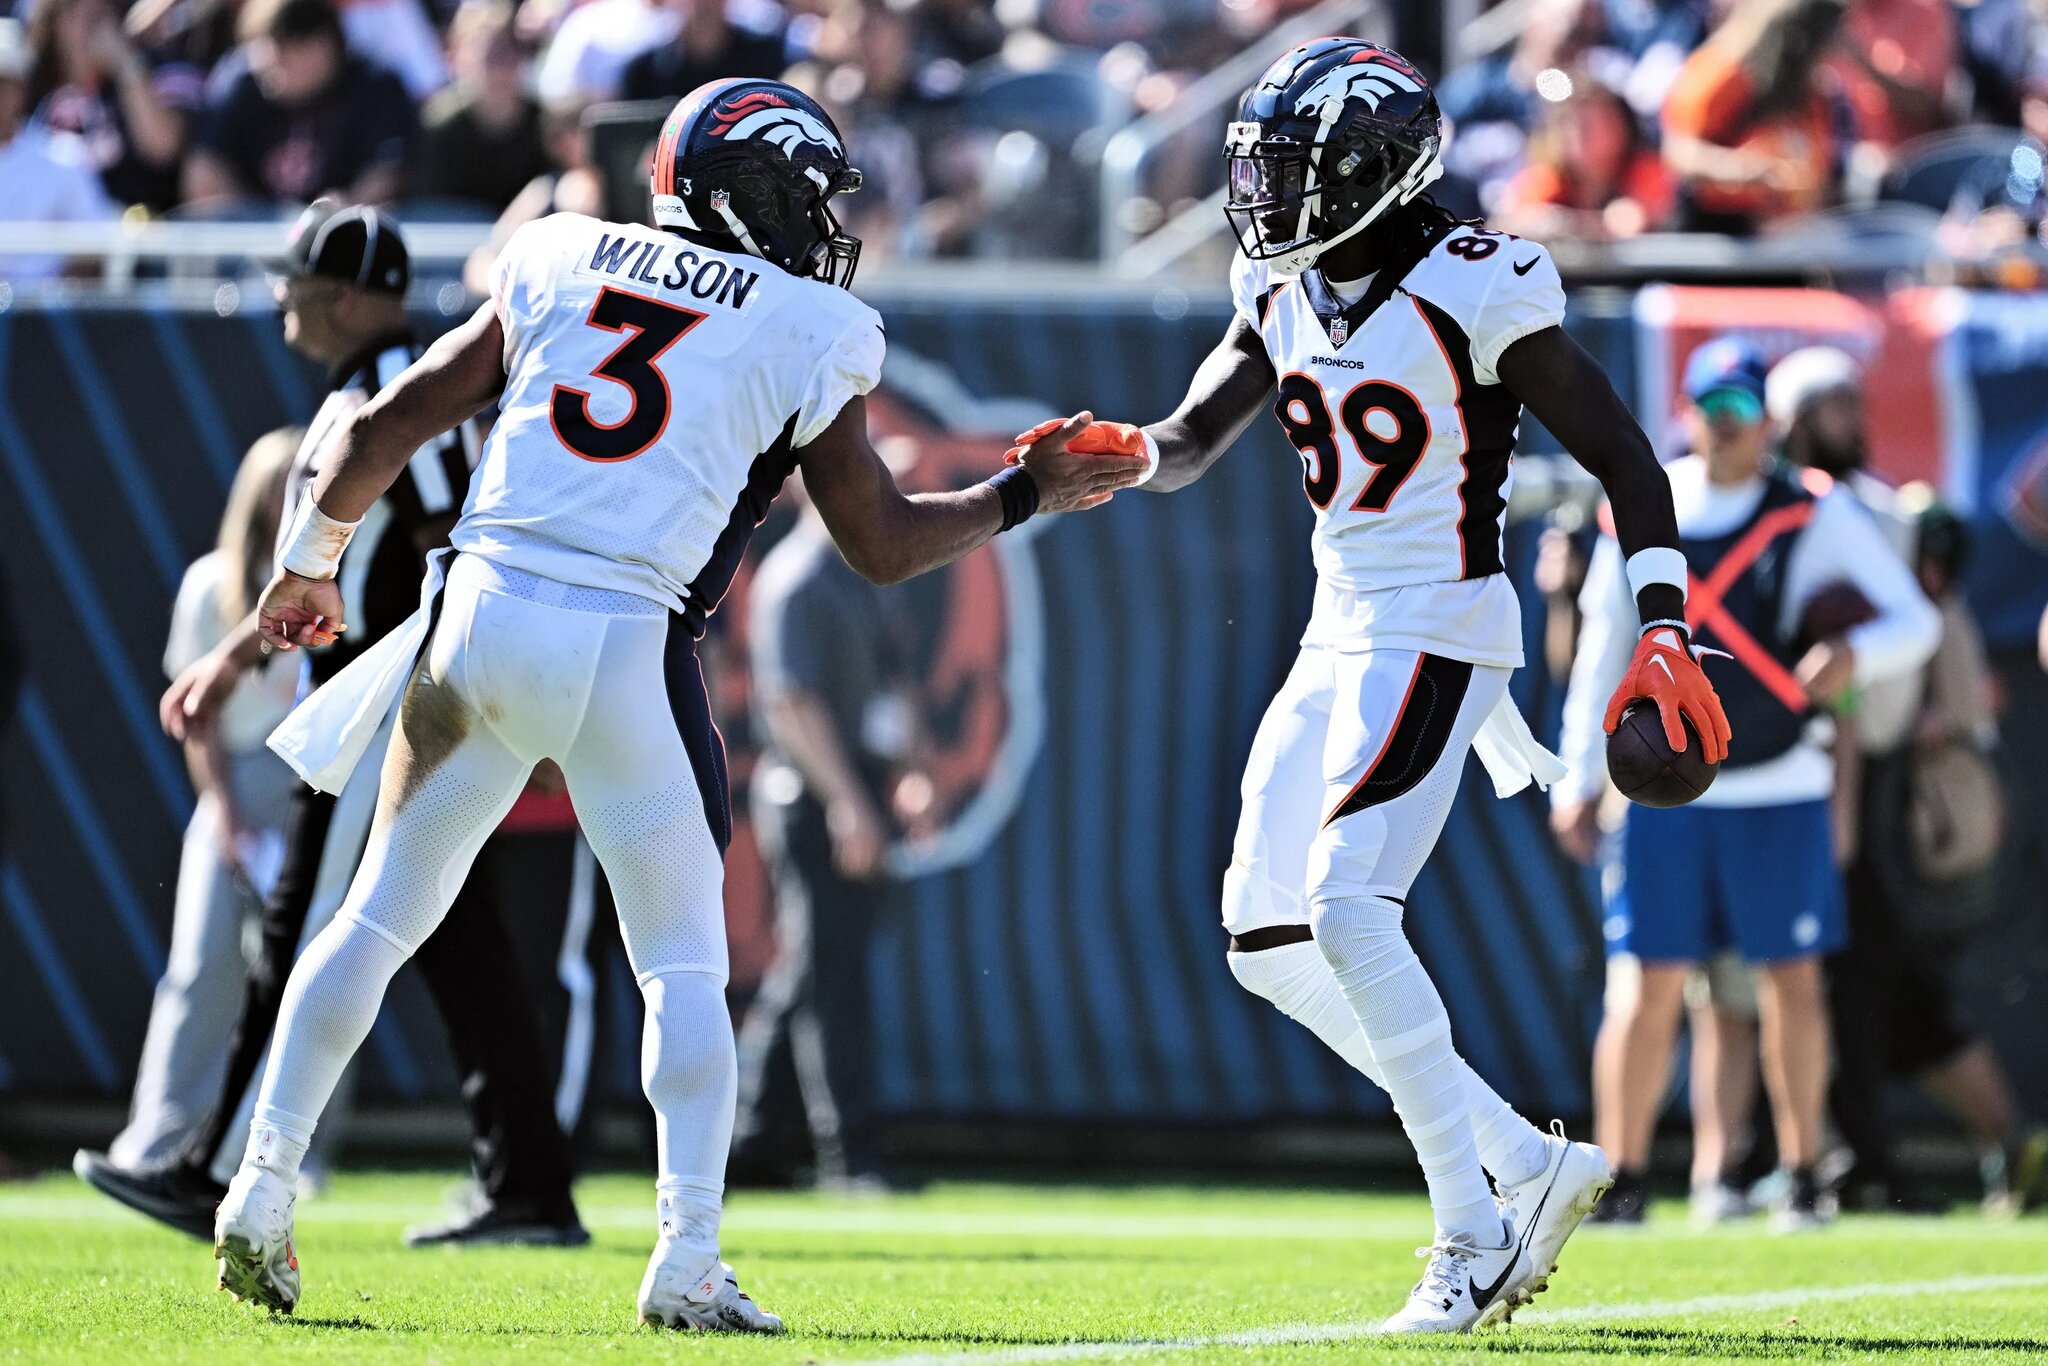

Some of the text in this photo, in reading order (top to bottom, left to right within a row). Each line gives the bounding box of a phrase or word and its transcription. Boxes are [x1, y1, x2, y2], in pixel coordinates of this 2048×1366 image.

[683, 179, 693, 195] 3
[590, 234, 759, 309] WILSON
[549, 285, 710, 463] 3
[1311, 356, 1365, 370] BRONCOS
[1274, 371, 1432, 513] 89
